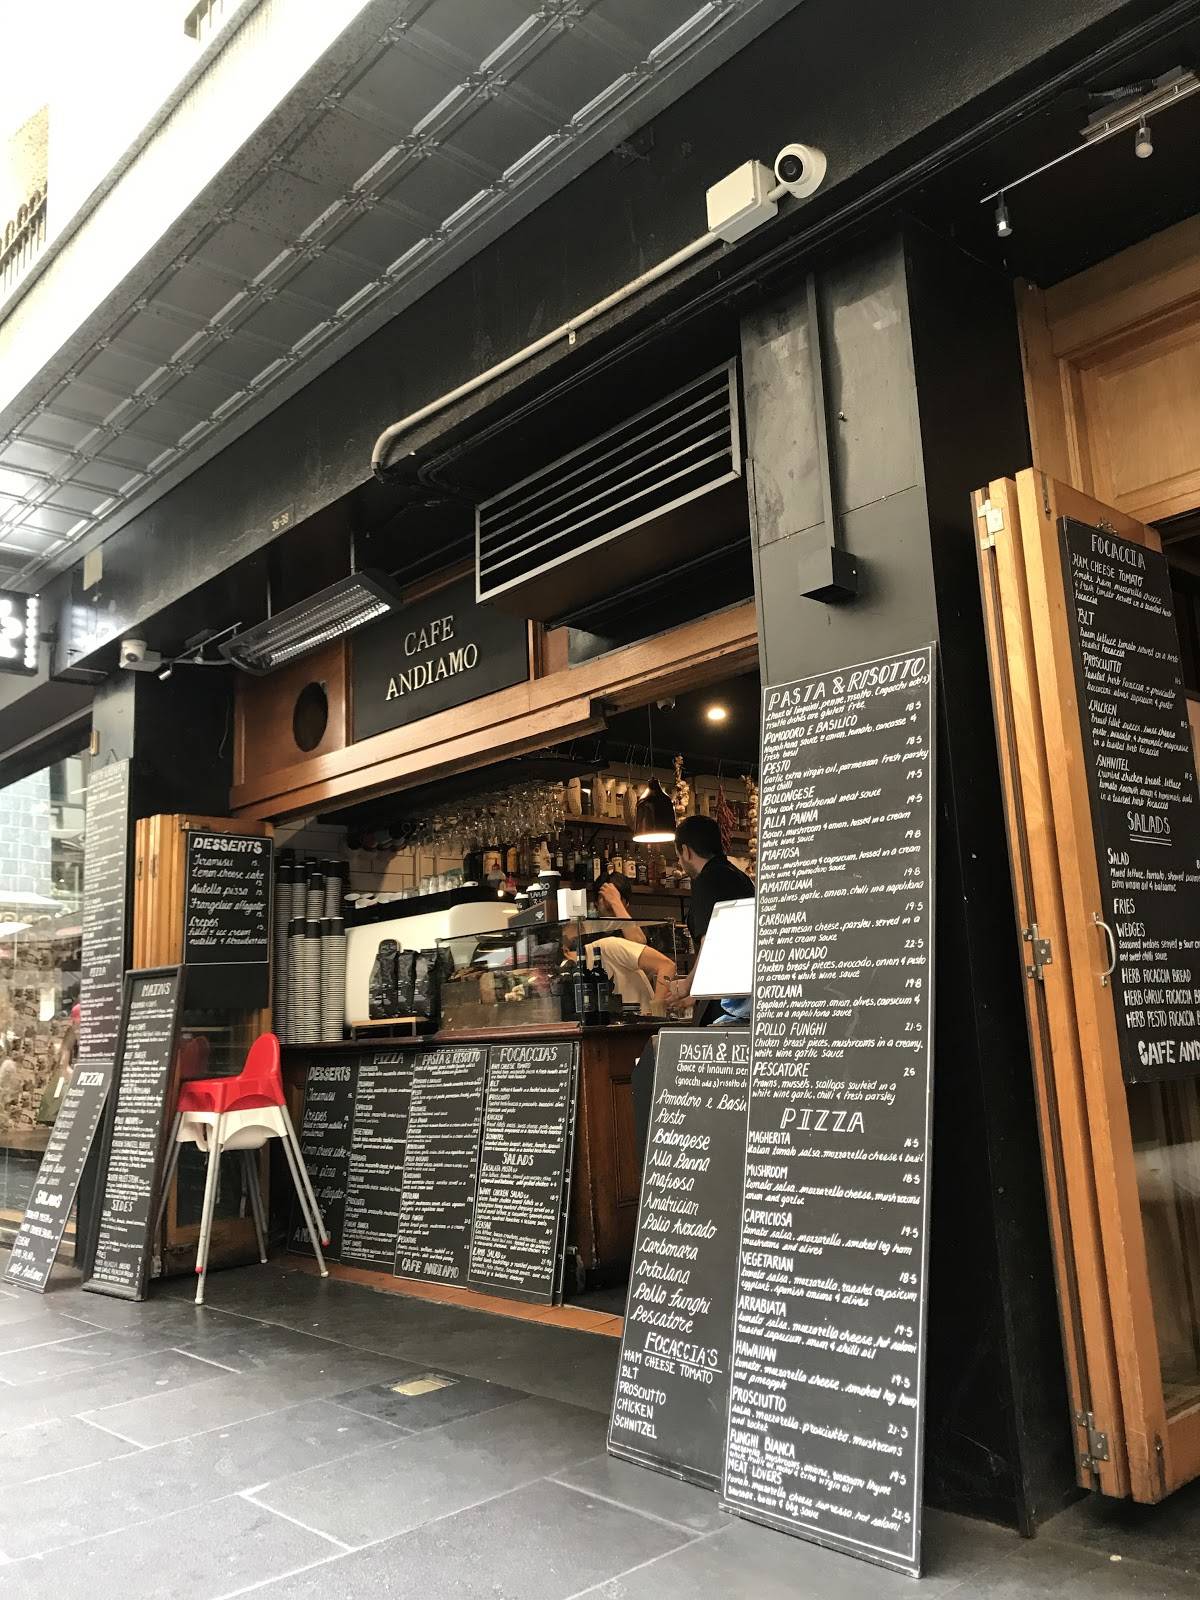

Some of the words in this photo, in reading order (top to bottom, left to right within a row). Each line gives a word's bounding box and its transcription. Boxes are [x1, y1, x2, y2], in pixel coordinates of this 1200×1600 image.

[1091, 534, 1146, 570] FOCACCIA
[1091, 560, 1115, 578] CHEESE
[1119, 570, 1144, 587] TOMATO
[1078, 608, 1094, 626] BLT
[404, 615, 454, 656] CAFE
[386, 644, 478, 701] ANDIAMO
[768, 682, 826, 711] PASTA
[833, 676, 845, 694] &
[847, 657, 925, 692] RISOTTO
[1088, 700, 1118, 716] CHICKEN
[764, 727, 805, 745] POMODORO
[807, 724, 813, 734] E
[816, 715, 858, 733] BASILICO
[763, 760, 790, 775] PESTO
[763, 786, 815, 806] BOLONGESE
[860, 788, 881, 798] sauce
[763, 813, 785, 829] ALLA
[788, 809, 818, 826] PANNA
[1126, 811, 1171, 834] SALADS
[193, 838, 262, 854] DESSERTS
[762, 847, 799, 862] MAFIOSA
[760, 879, 813, 894] AMATRICIANA
[1114, 898, 1135, 914] FRIES
[759, 912, 807, 926] CARBONARA
[1116, 922, 1145, 937] WEDGES
[757, 949, 785, 962] POLLO
[788, 946, 827, 960] AVOCADO
[1121, 968, 1140, 984] HERB
[1143, 968, 1171, 984] FOCACCIA
[1172, 968, 1191, 983] BREAD
[142, 983, 171, 996] MAINS
[757, 984, 803, 998] ORTOLANA
[1124, 990, 1143, 1006] HERB
[1144, 990, 1164, 1005] GARLIC
[1166, 990, 1193, 1006] FOCACCIA
[1126, 1010, 1145, 1029] HERB
[1147, 1010, 1167, 1029] PESTO
[1169, 1010, 1196, 1028] FOCACCIA
[756, 1022, 786, 1036] POLLO
[790, 1022, 827, 1035] FUNGHI
[373, 1053, 404, 1064] PIZZA
[422, 1054, 444, 1065] PASTA
[445, 1054, 451, 1064] &
[452, 1052, 480, 1063] RISOTTO
[679, 1044, 713, 1061] PASTA
[716, 1043, 727, 1060] &
[821, 1049, 844, 1058] sauce
[77, 1072, 104, 1086] PIZZA
[308, 1066, 351, 1081] DESSERTS
[753, 1063, 810, 1077] PESCATORE
[656, 1089, 701, 1108] Pomodoro
[655, 1108, 686, 1125] Pesto
[780, 1107, 864, 1133] PIZZA
[749, 1131, 791, 1145] MAGHERITA
[502, 1153, 534, 1166] SALADS
[650, 1150, 671, 1168] Alla
[674, 1153, 710, 1172] Panna
[747, 1164, 788, 1179] MUSHROOM
[111, 1200, 133, 1213] SIDES
[744, 1209, 793, 1227] CAPRICIOSA
[672, 1220, 717, 1239] Avocado
[402, 1258, 421, 1273] CAFE
[424, 1262, 459, 1278] ANDIAMO
[741, 1252, 794, 1272] VEGETARIAN
[738, 1296, 787, 1317] ARRABIATA
[736, 1340, 777, 1362] HAWAIIAN
[622, 1365, 639, 1380] BLT
[624, 1350, 642, 1364] HAM
[645, 1356, 675, 1374] CHEESE
[680, 1364, 713, 1384] TOMATO
[619, 1382, 666, 1406] PROSCIUTTO
[732, 1386, 786, 1412] PROSCIUTTO
[617, 1398, 653, 1419] CHICKEN
[615, 1415, 657, 1439] SCHNITZEL
[730, 1429, 759, 1448] FUNGHI
[765, 1437, 795, 1459] BIANCA
[728, 1458, 748, 1475] MEAT
[752, 1466, 782, 1485] LOVERS
